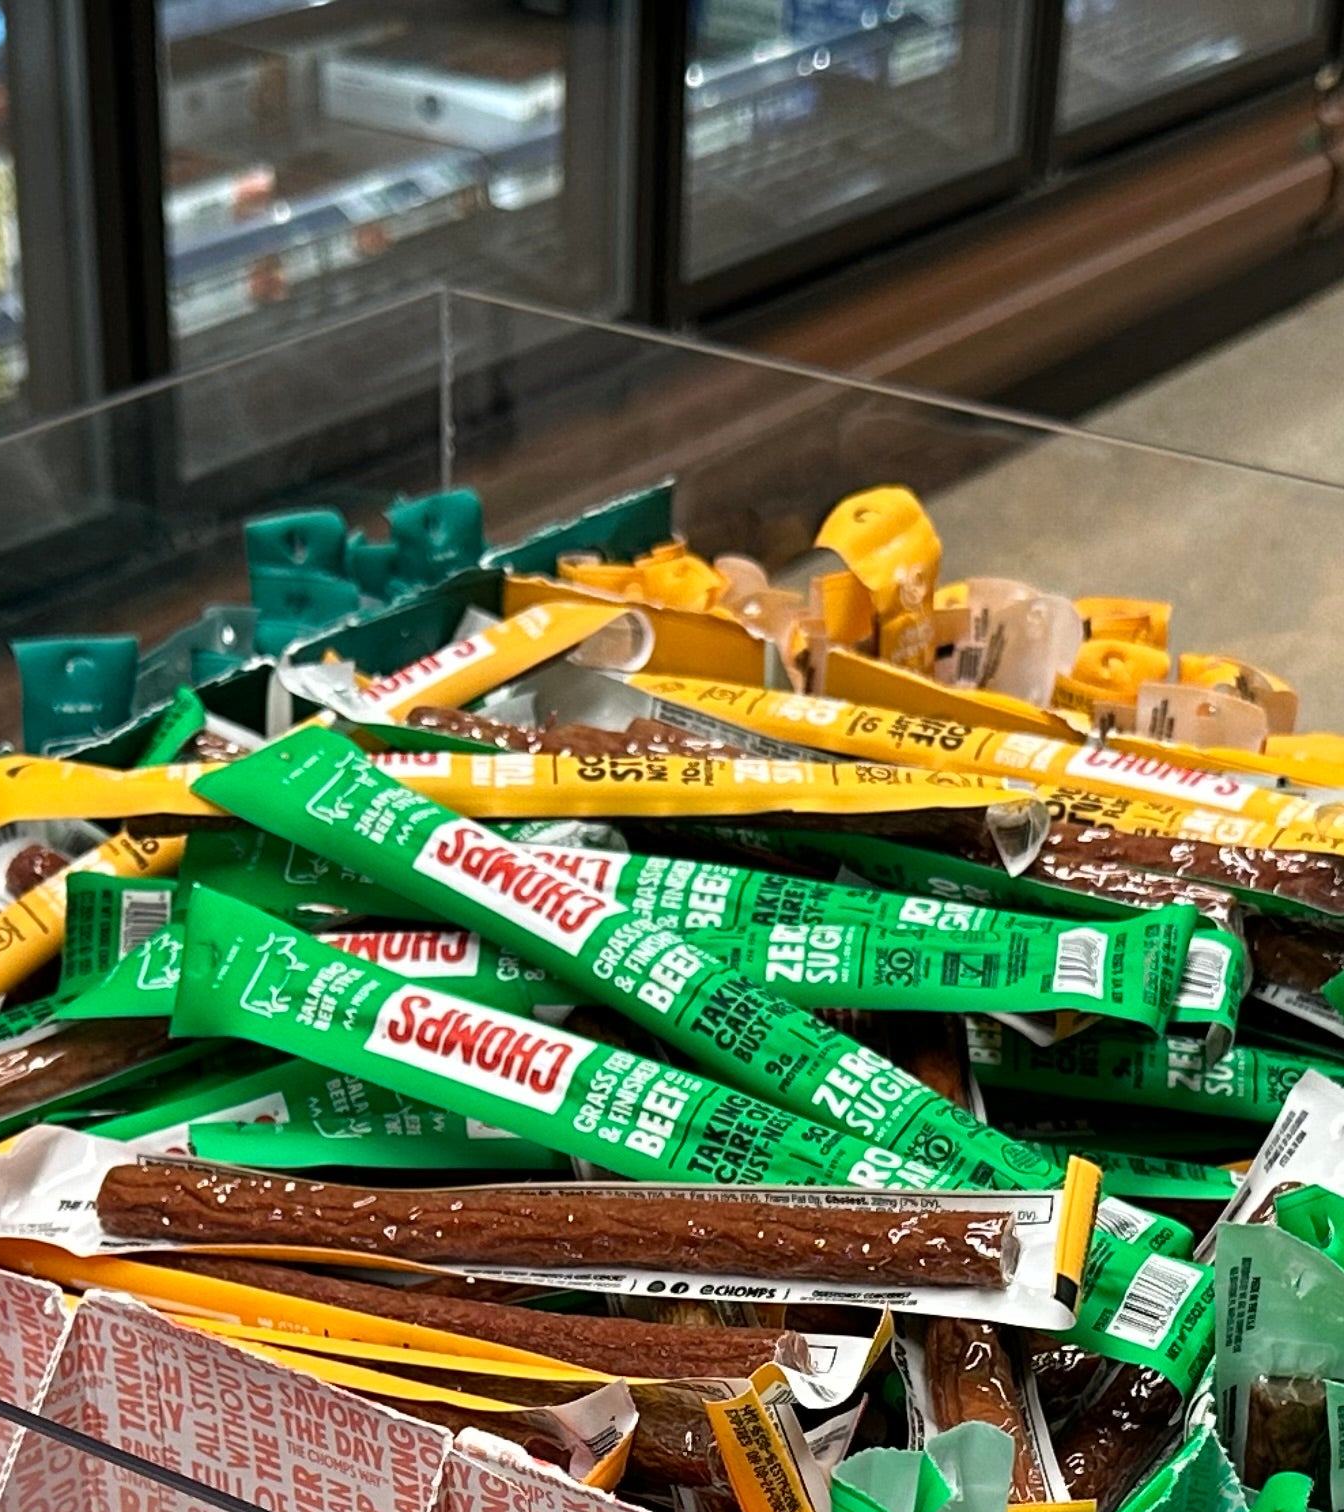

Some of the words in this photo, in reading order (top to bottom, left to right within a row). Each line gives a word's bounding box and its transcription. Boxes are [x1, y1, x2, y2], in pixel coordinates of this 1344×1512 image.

[436, 828, 599, 926] CHOMPS
[313, 991, 337, 1031] BEEF
[329, 968, 366, 995] STICK
[388, 995, 573, 1094] CHOMPS
[765, 1052, 794, 1077] 9G
[780, 1054, 810, 1094] PROTEIN
[573, 1069, 611, 1133] GRASS
[608, 1060, 660, 1125] FINISHED
[812, 1046, 893, 1119] ZERO
[624, 1079, 690, 1159] BEEF
[687, 1094, 753, 1173] TAKING
[699, 1284, 777, 1299] @CHOMPS
[278, 1381, 380, 1441] SAVORY
[280, 1410, 328, 1449] THE
[334, 1428, 384, 1471] DAY
